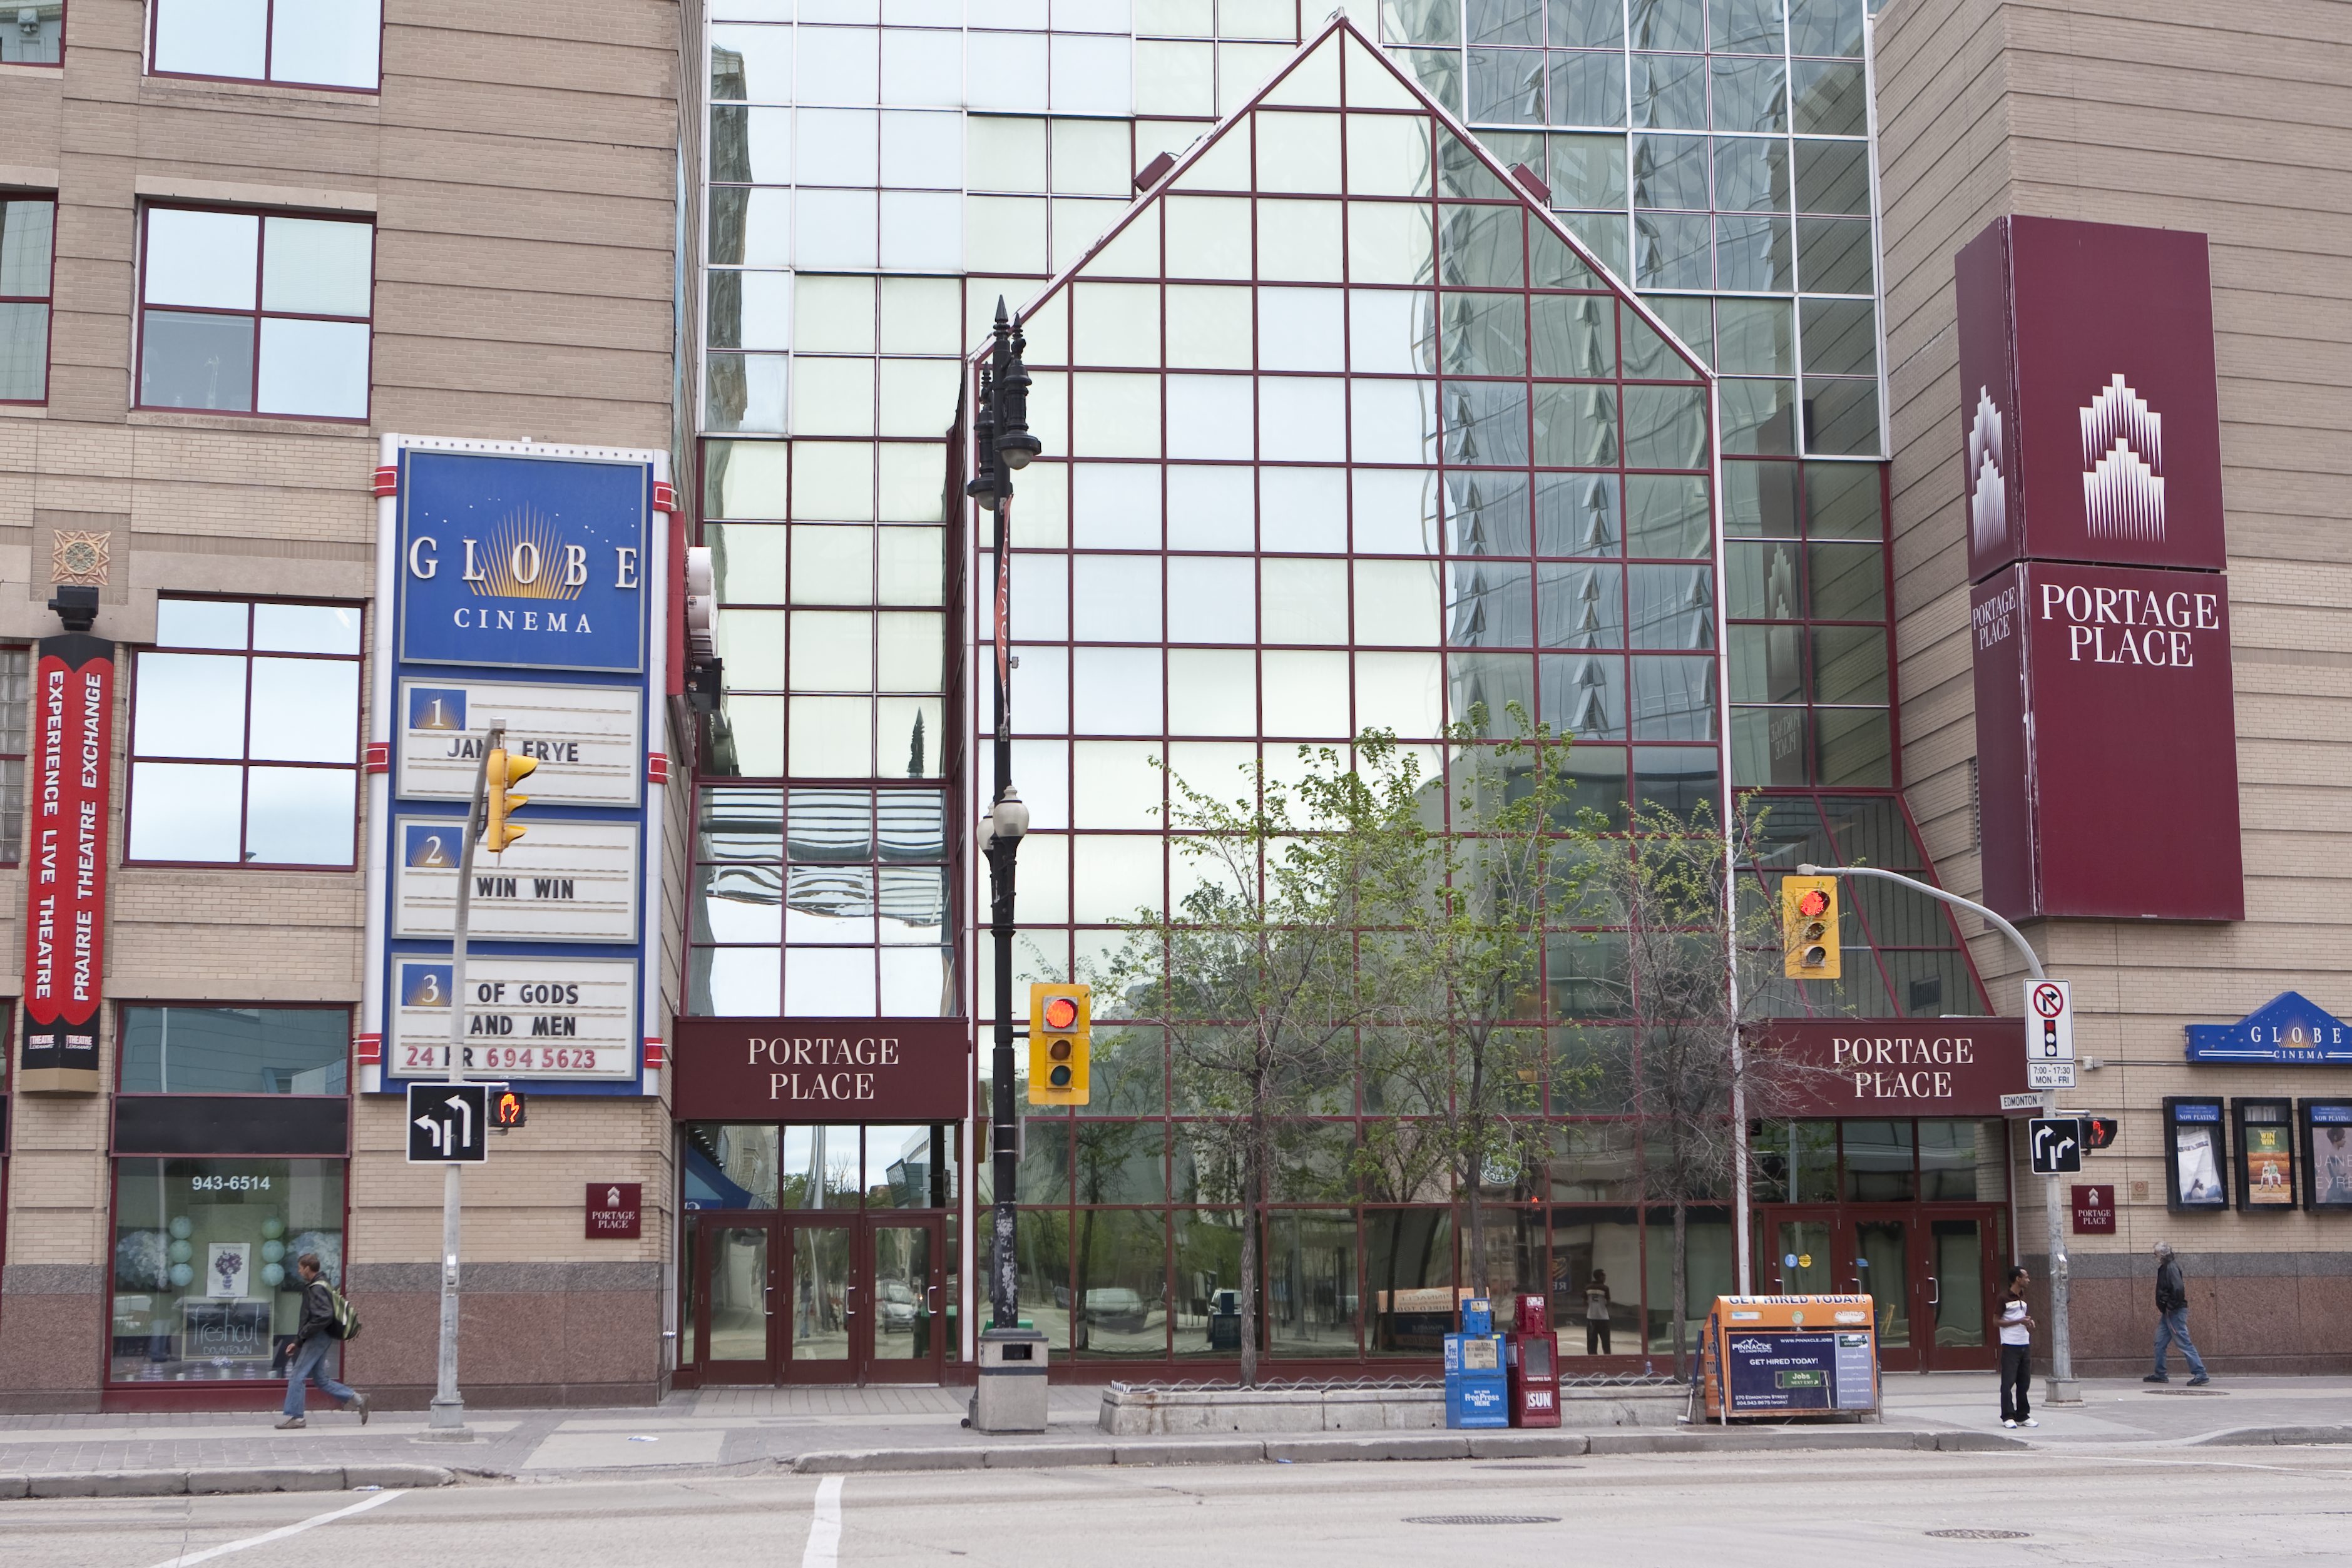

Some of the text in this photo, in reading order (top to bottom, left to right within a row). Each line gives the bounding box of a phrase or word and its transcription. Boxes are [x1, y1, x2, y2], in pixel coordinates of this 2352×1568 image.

[409, 536, 638, 589] GLOBE
[1972, 586, 2016, 631] PORTAGE
[2040, 583, 2219, 629] PORTAGE
[454, 608, 592, 633] CINEMA
[1978, 614, 2010, 650] PLACE
[2068, 624, 2193, 667] PLACE
[431, 698, 444, 726] 1
[447, 738, 579, 762] JAN ERYE
[36, 670, 64, 1000] EXPERIENCE LIVE THEATRE
[73, 672, 101, 1002] PRAIRIE THEATRE EXCHANGE
[426, 835, 442, 864] 2
[476, 877, 574, 899] WIN WIN
[422, 974, 439, 1002] 3
[478, 983, 579, 1004] OF GODS
[470, 1015, 575, 1036] AND MEN
[2251, 1026, 2342, 1044] GLOBE
[33, 1035, 54, 1044] THEATRE
[69, 1036, 93, 1045] THEATRE
[406, 1046, 434, 1066] 24
[486, 1047, 533, 1068] 694
[541, 1048, 595, 1069] 5623
[748, 1037, 899, 1065] PORTAGE
[1833, 1038, 1973, 1064] PORTAGE
[2273, 1050, 2324, 1059] CINEMA
[769, 1073, 874, 1101] PLACE
[1854, 1072, 1952, 1097] PLACE
[2003, 1095, 2037, 1107] EDMONTON
[2316, 1154, 2352, 1168] JANE
[192, 1176, 271, 1191] 943-6514
[592, 1211, 635, 1221] PORTAGE
[2078, 1209, 2112, 1218] PORTAGE
[2083, 1217, 2107, 1225] PLACE
[598, 1220, 629, 1229] PLACE
[1729, 1295, 1867, 1305] GET HIRED TODAY!
[1446, 1355, 1458, 1367] Press
[1448, 1345, 1457, 1356] Free
[1506, 1345, 1517, 1365] UN
[1530, 1393, 1551, 1407] SUN
